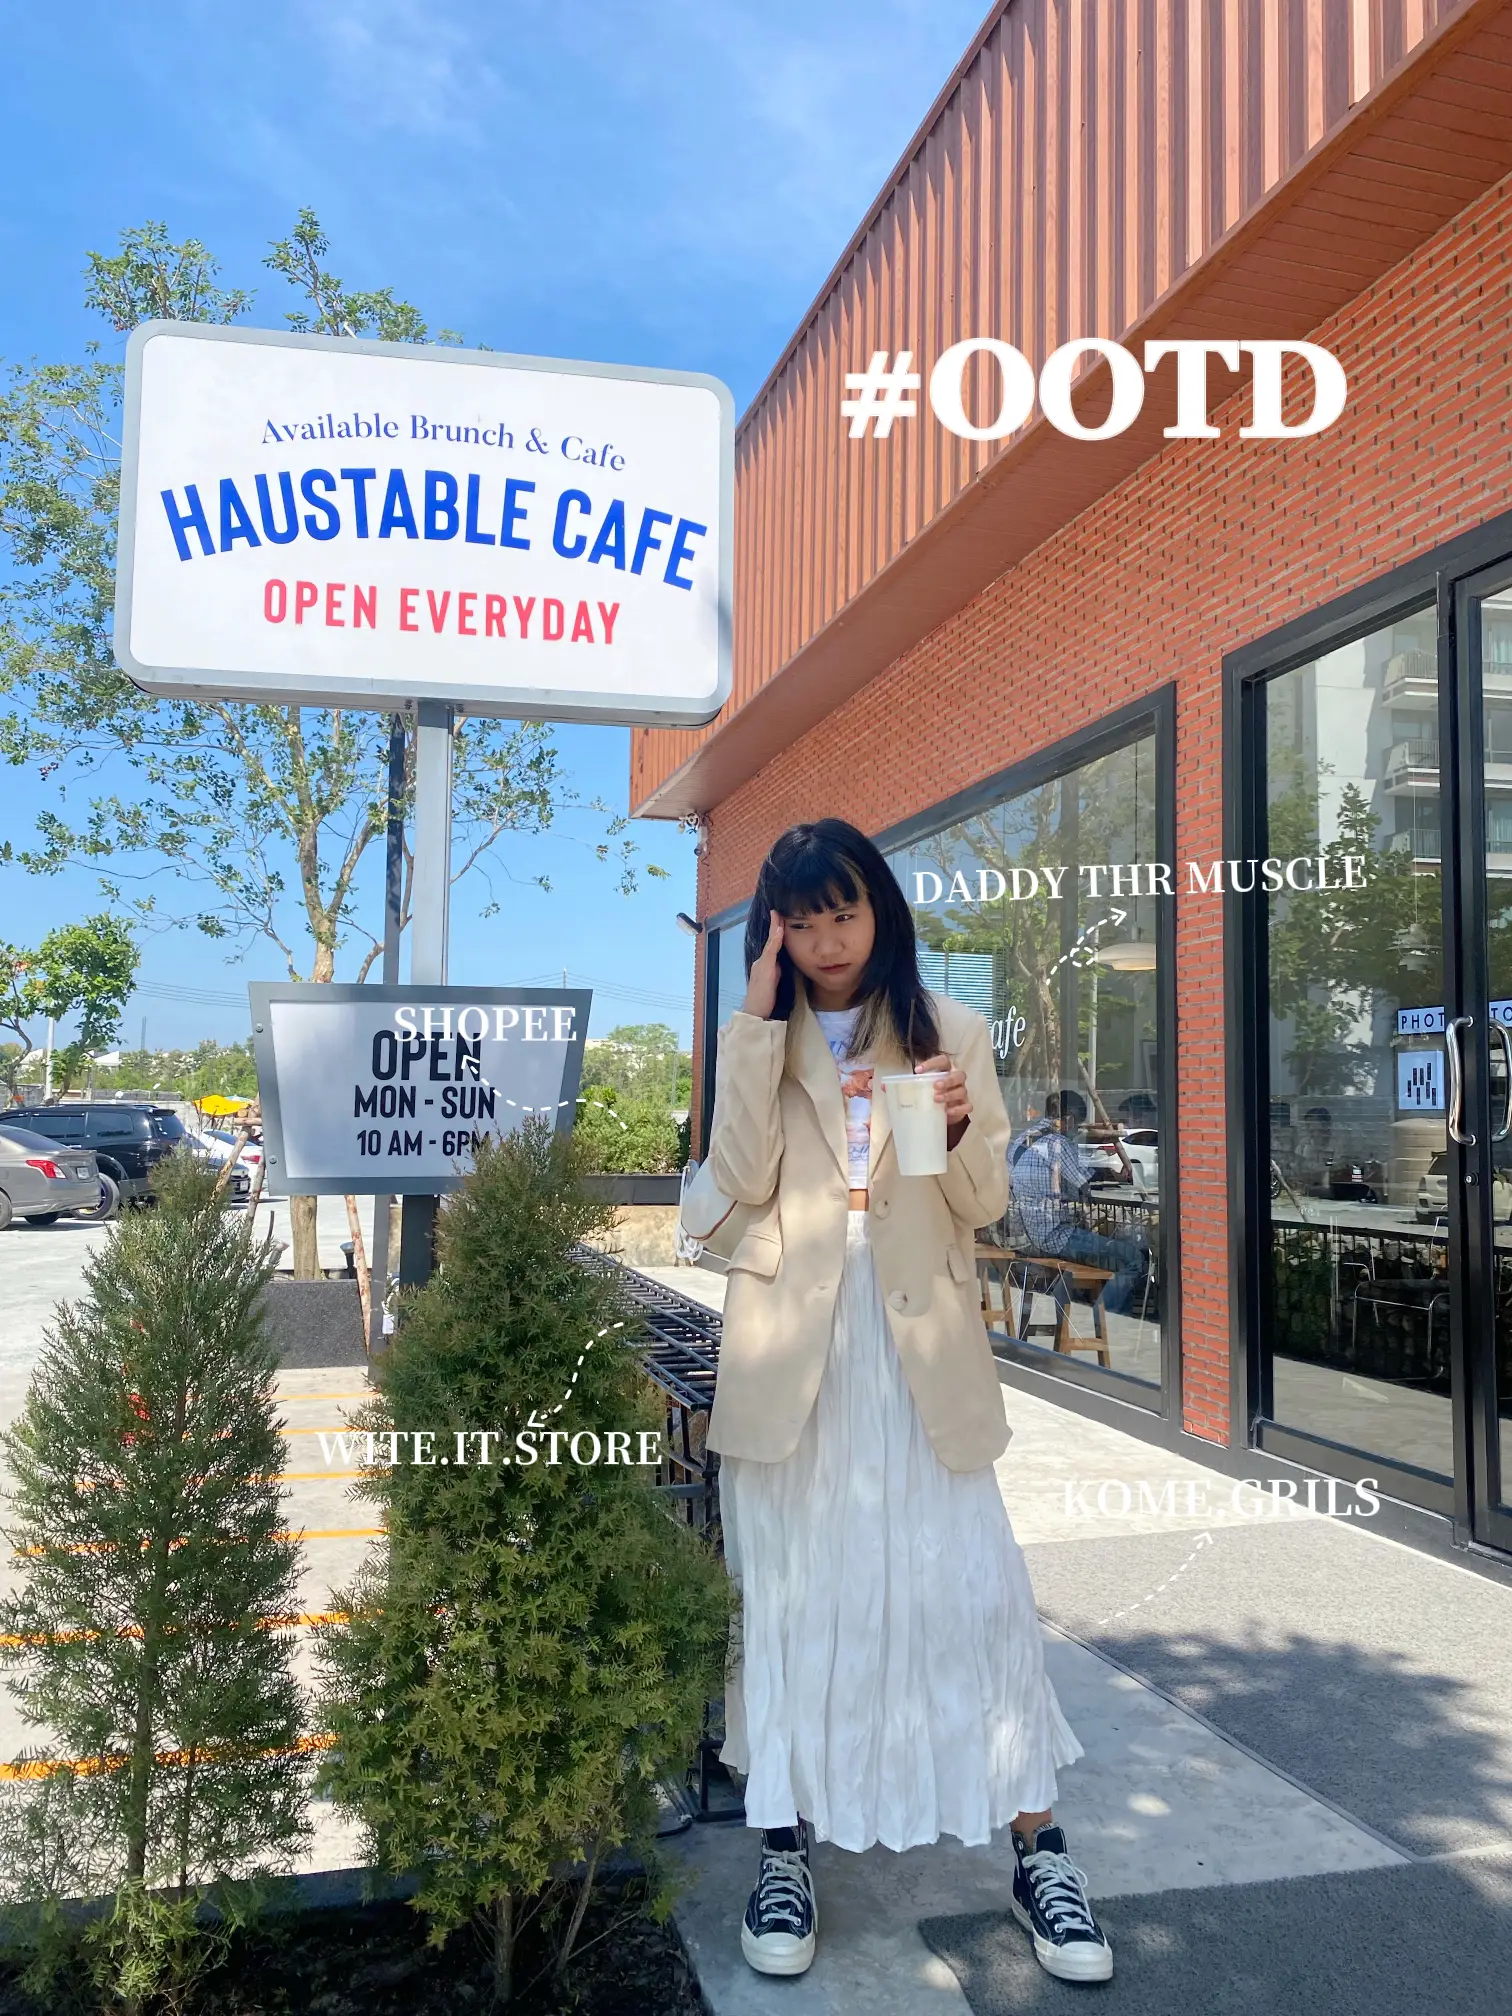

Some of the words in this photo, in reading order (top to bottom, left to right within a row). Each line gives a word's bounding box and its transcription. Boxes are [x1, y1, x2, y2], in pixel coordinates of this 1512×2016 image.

[262, 413, 399, 444] Available
[411, 414, 514, 448] Brunch
[526, 428, 549, 454] &
[561, 436, 626, 472] Cafe
[161, 467, 537, 562] HAUSTABLE
[553, 488, 708, 591] CAFE
[264, 578, 377, 629] OPEN
[400, 588, 620, 645] EVERYDAY
[372, 1029, 481, 1082] OPEN
[990, 1005, 1026, 1059] afe
[354, 1084, 417, 1119] MON
[441, 1086, 496, 1119] SUN
[357, 1129, 382, 1156] 10
[387, 1130, 423, 1156] AM
